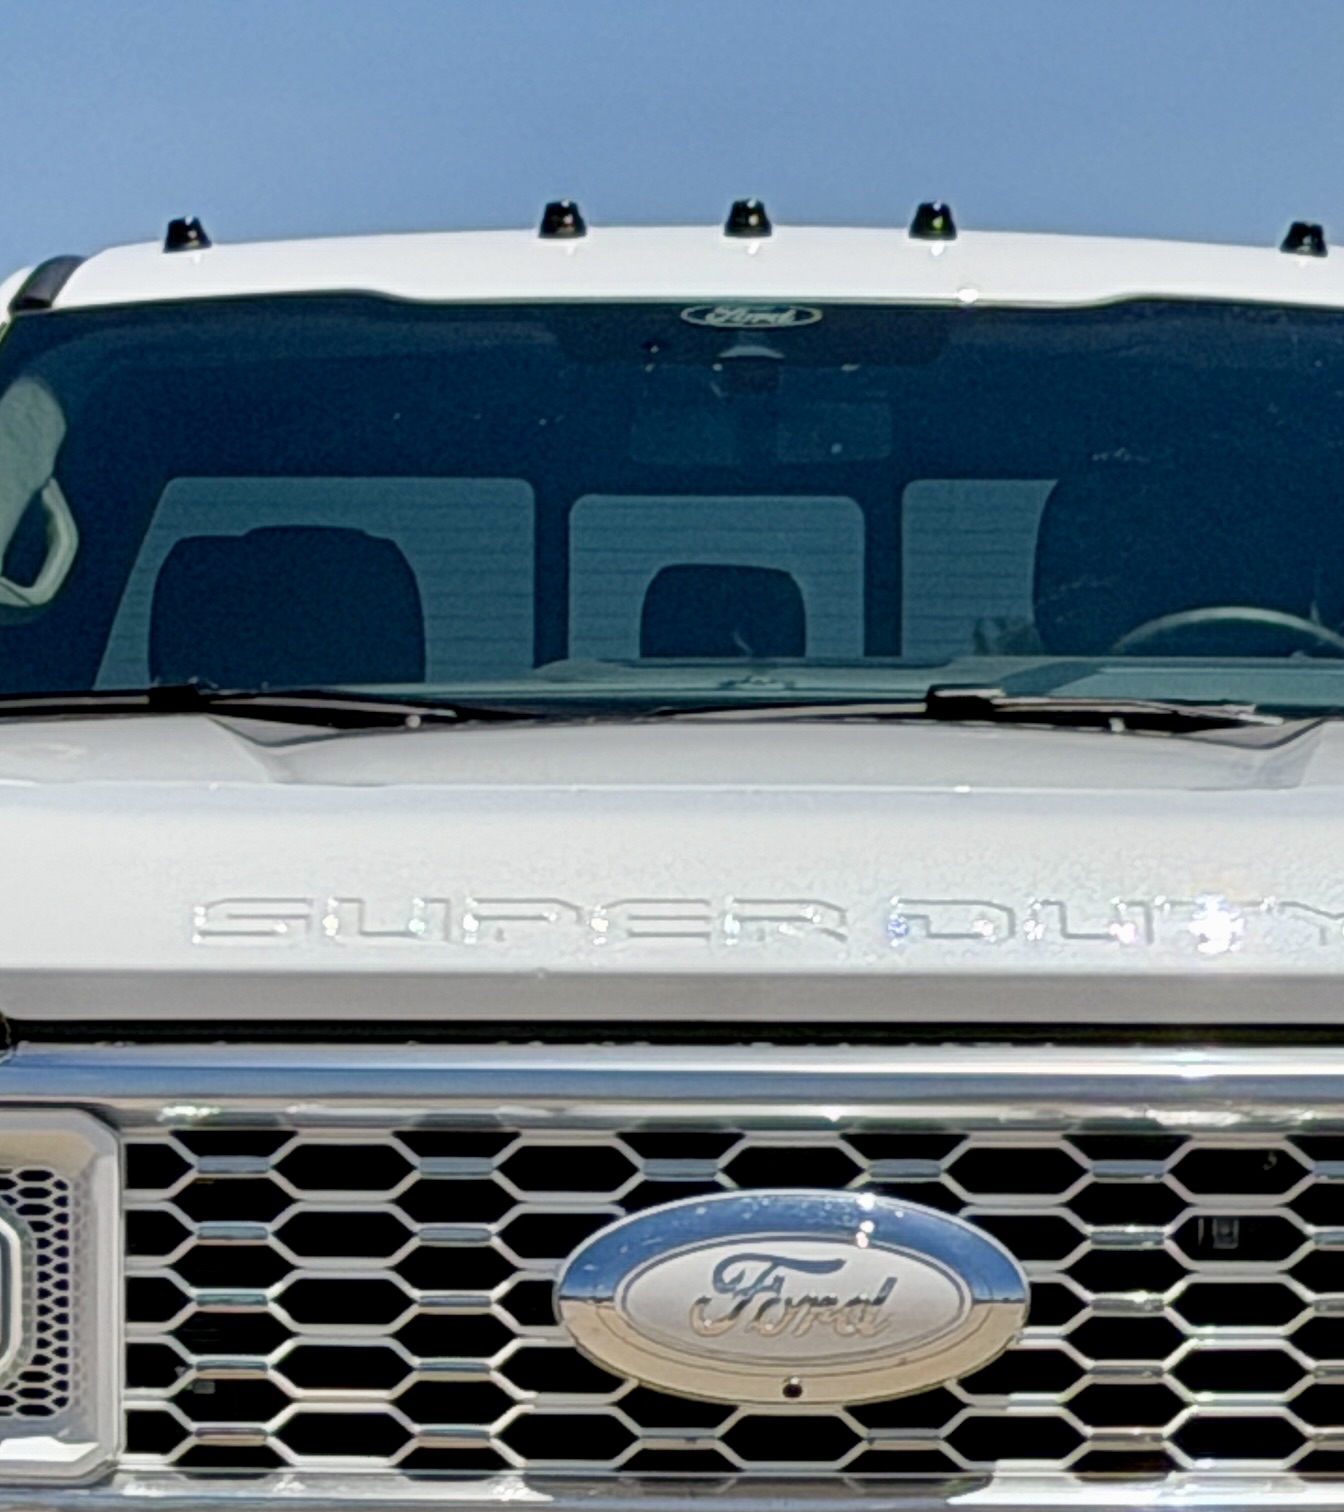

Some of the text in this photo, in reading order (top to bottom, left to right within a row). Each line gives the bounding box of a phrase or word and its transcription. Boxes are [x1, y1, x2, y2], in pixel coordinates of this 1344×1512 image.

[705, 306, 797, 327] Ford
[192, 897, 849, 945] SUPER
[689, 1251, 898, 1338] Ford
